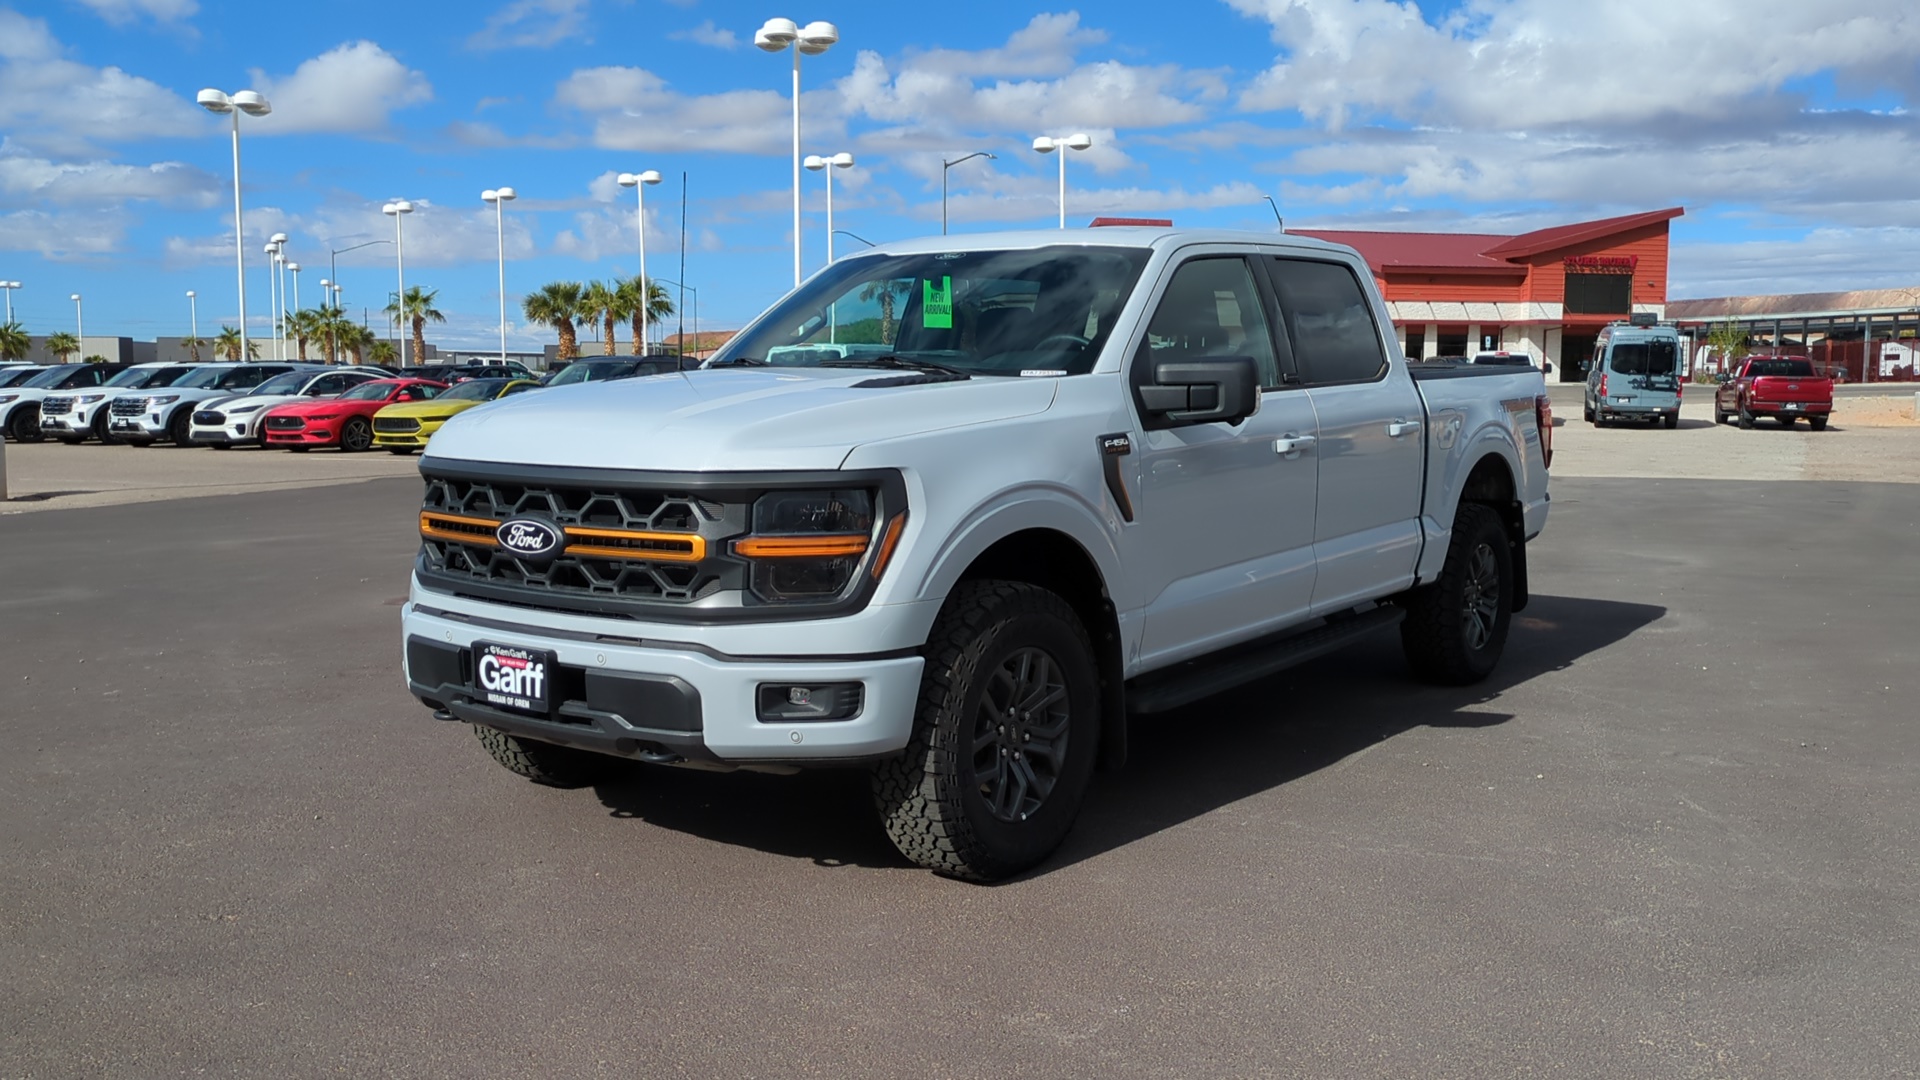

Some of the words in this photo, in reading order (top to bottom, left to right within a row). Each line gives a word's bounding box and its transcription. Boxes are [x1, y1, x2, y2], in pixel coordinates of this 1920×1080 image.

[930, 292, 946, 303] NEW
[925, 304, 951, 315] ARRIVAL!
[507, 524, 544, 549] Ford
[479, 654, 544, 698] Garff
[487, 693, 506, 703] NISSAN
[507, 697, 513, 705] OF
